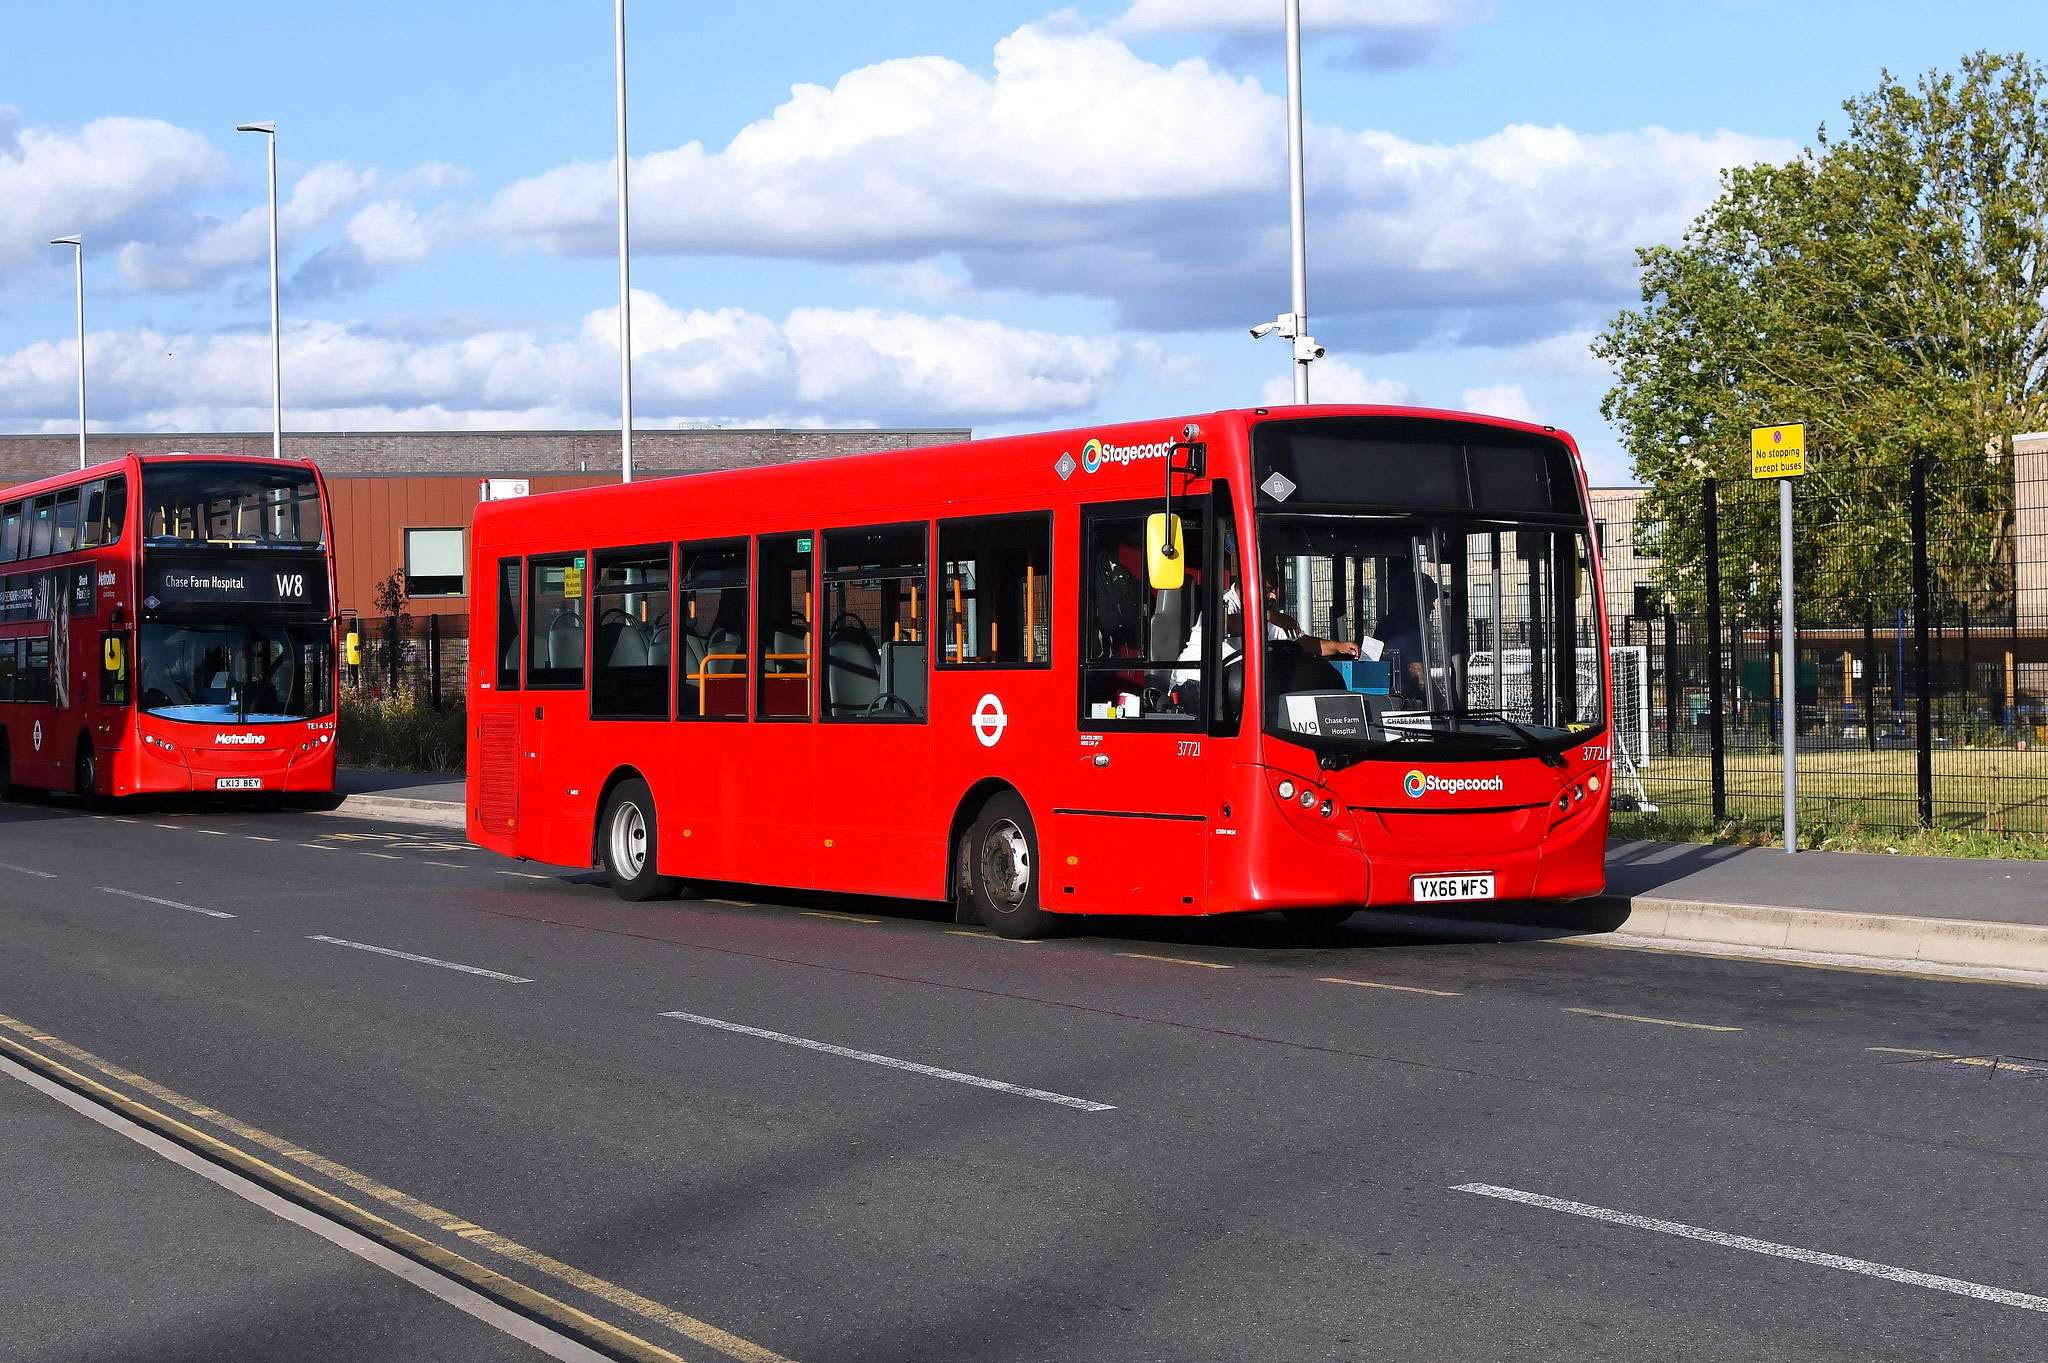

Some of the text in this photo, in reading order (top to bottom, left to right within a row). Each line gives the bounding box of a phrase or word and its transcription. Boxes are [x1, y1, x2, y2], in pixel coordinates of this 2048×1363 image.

[1101, 436, 1177, 466] Stagecoach
[1756, 447, 1800, 459] No stopping
[1754, 462, 1802, 473] except buses
[165, 575, 245, 592] Chase Farm Hospital
[276, 574, 303, 597] W8
[307, 721, 333, 730] TE1435
[1324, 716, 1360, 724] Chase Farm
[1409, 717, 1425, 725] FARM
[1291, 721, 1318, 734] W9
[1331, 727, 1357, 735] Hospital
[215, 733, 265, 744] Metroline
[1177, 740, 1201, 757] 37721
[1582, 746, 1606, 761] 37721
[220, 779, 260, 788] LK13 BEY
[1426, 775, 1503, 794] Stagecoach
[1420, 879, 1489, 898] YX66 WFS
